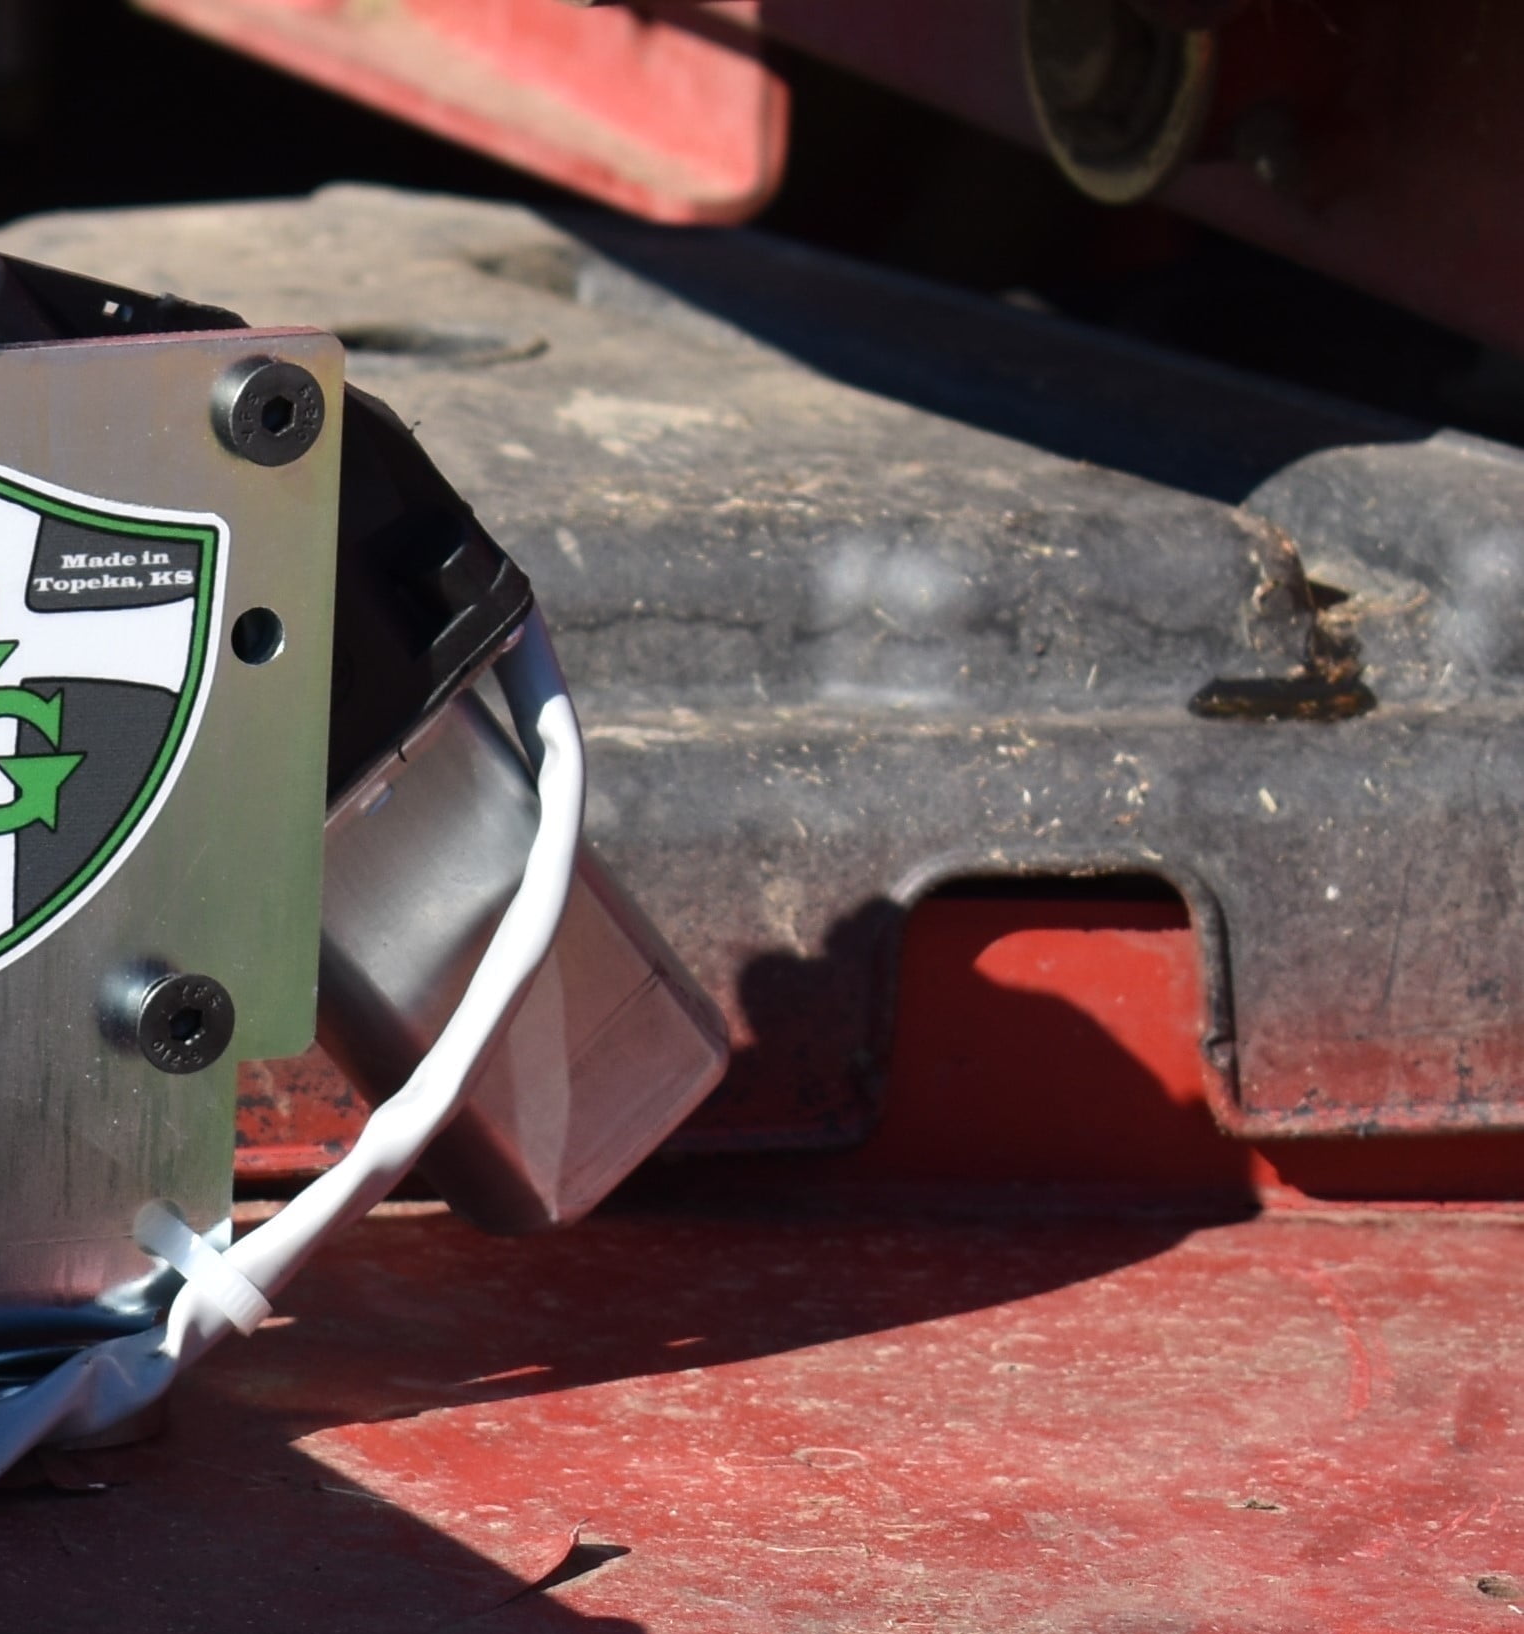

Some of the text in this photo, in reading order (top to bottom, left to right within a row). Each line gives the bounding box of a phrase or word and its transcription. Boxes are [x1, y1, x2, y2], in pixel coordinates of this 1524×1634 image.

[61, 550, 170, 569] Made in
[33, 569, 195, 594] Topeka, KS
